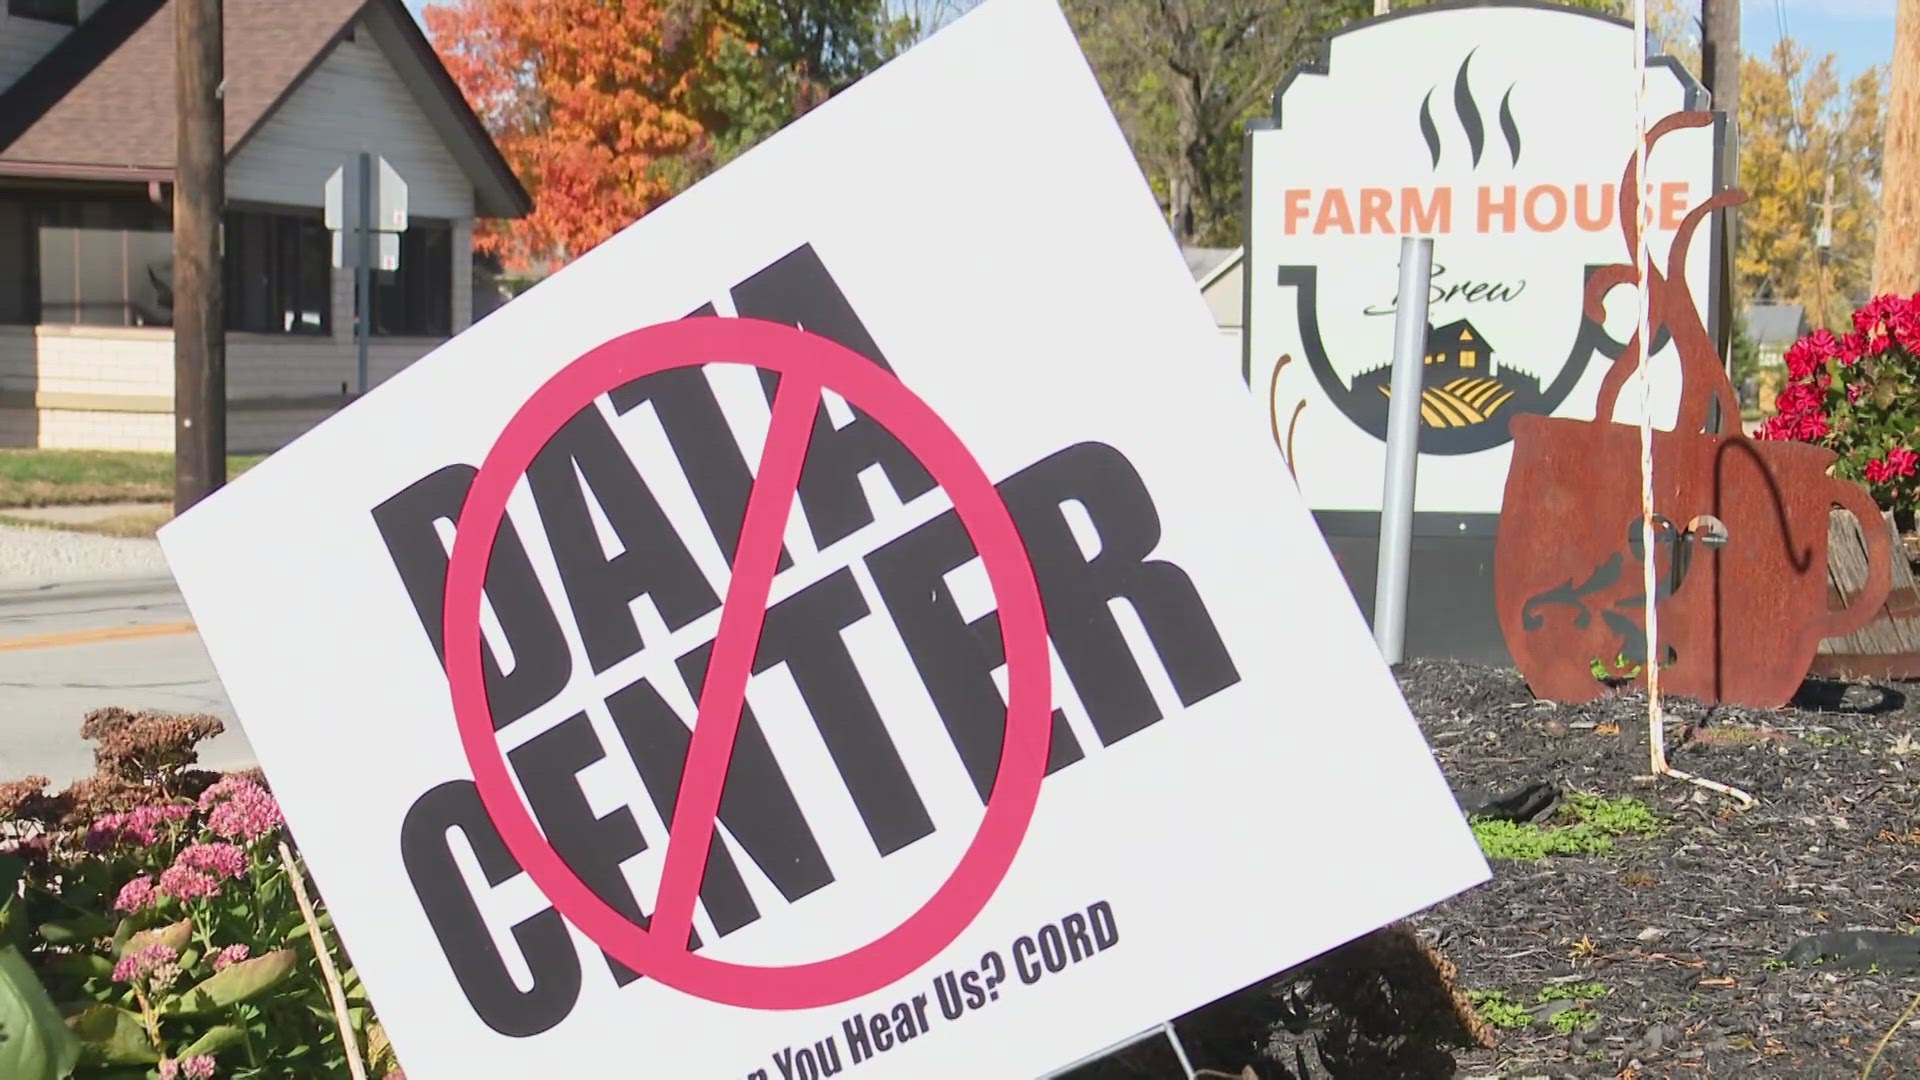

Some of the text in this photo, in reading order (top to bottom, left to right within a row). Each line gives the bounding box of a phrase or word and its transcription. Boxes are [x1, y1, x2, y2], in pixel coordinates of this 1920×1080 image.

[1284, 182, 1690, 235] FARM HOUE
[1363, 263, 1526, 315] Brew
[371, 242, 945, 732] DATA
[401, 441, 1241, 1038] CENTER
[772, 900, 1120, 1080] You Hear Us? CORD
